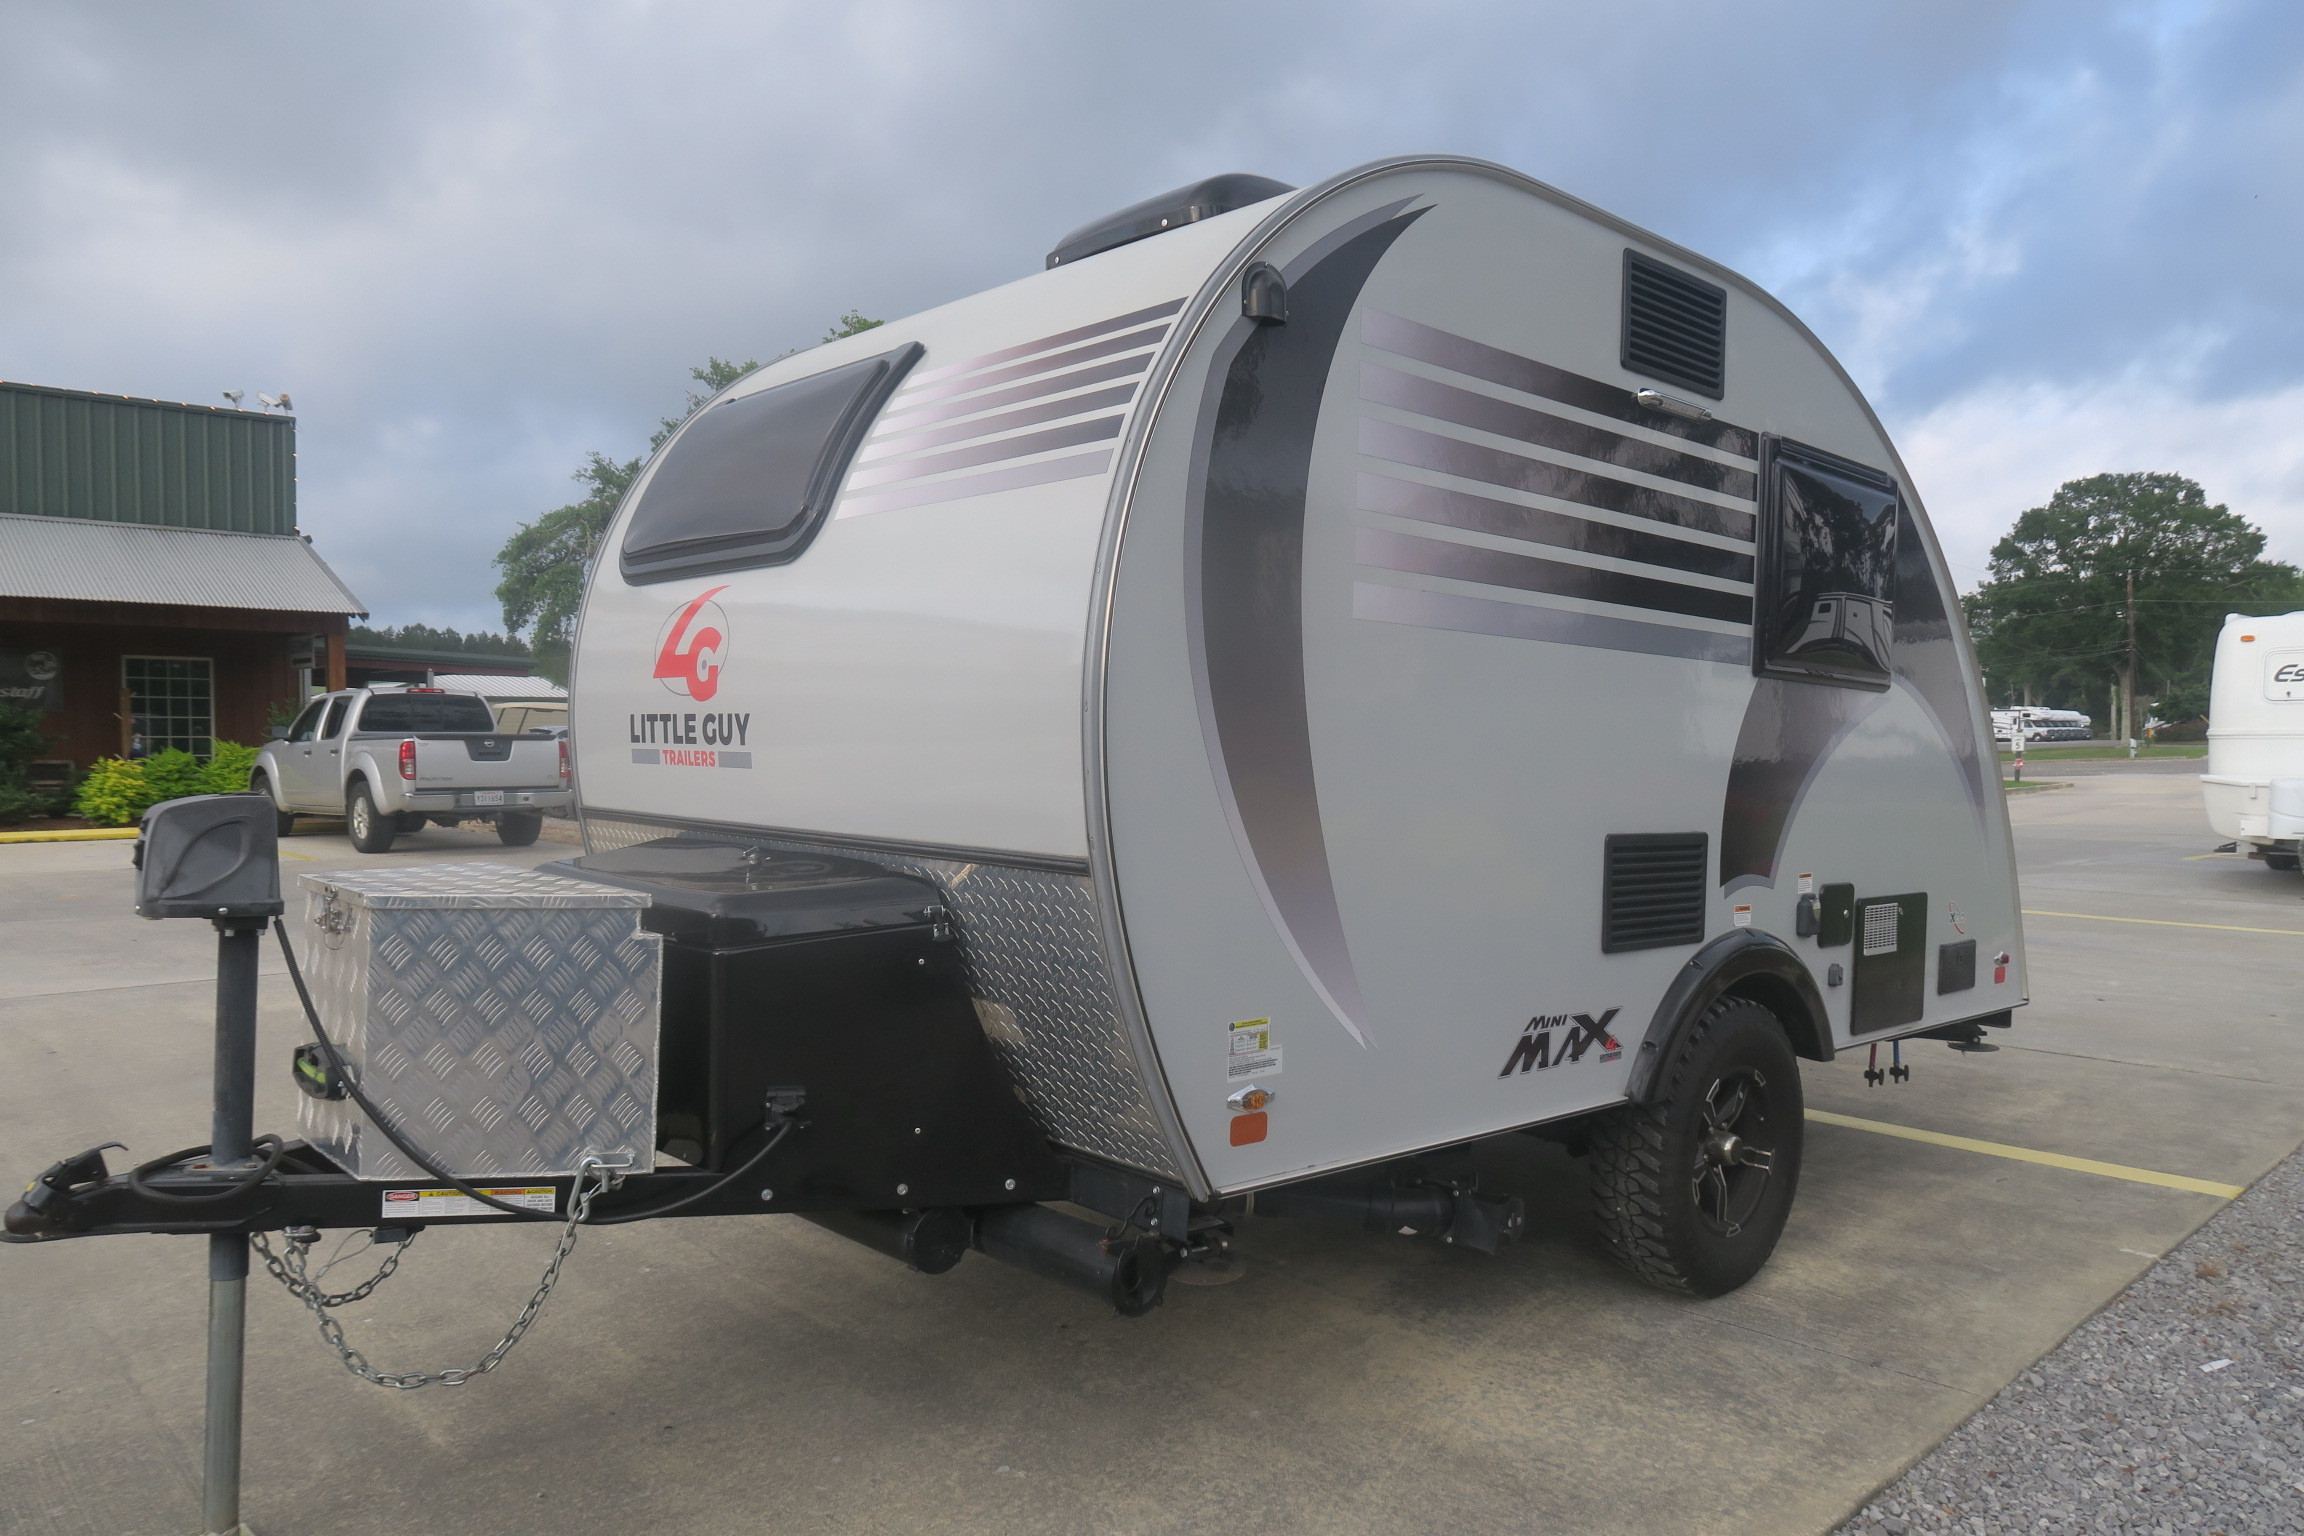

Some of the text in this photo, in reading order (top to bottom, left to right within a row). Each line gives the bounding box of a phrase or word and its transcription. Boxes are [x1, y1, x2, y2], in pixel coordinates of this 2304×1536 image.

[630, 713, 750, 745] LITTLE GUY
[662, 750, 716, 767] TRAILERS
[1498, 1006, 1622, 1079] MAX
